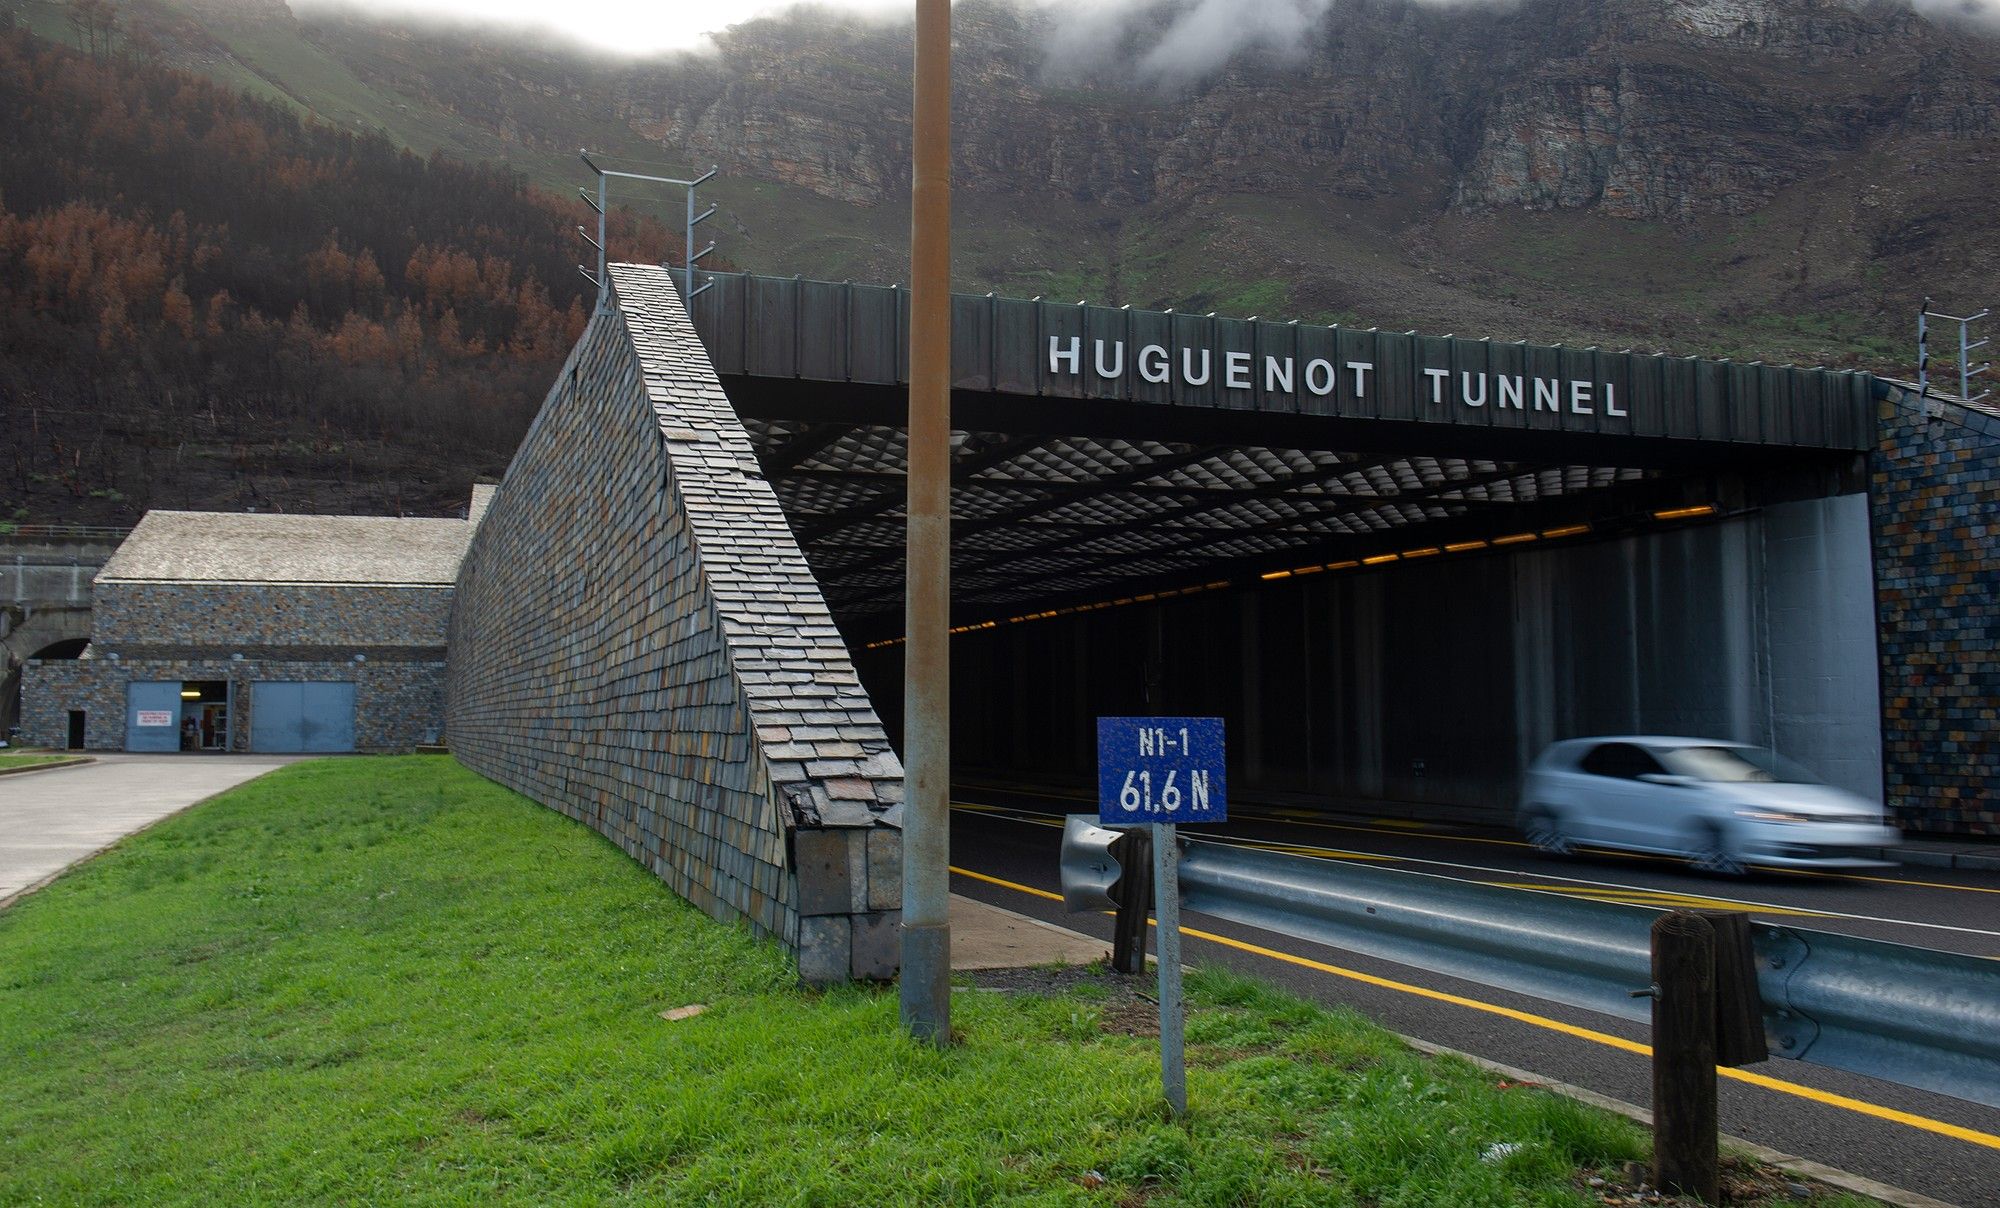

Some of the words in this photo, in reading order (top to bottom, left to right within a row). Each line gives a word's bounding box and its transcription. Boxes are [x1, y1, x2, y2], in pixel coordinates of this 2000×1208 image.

[1049, 335, 1373, 398] HUGUENOT
[1423, 367, 1628, 417] TUNNEL
[1139, 727, 1189, 757] N1-1
[1191, 769, 1209, 811] N
